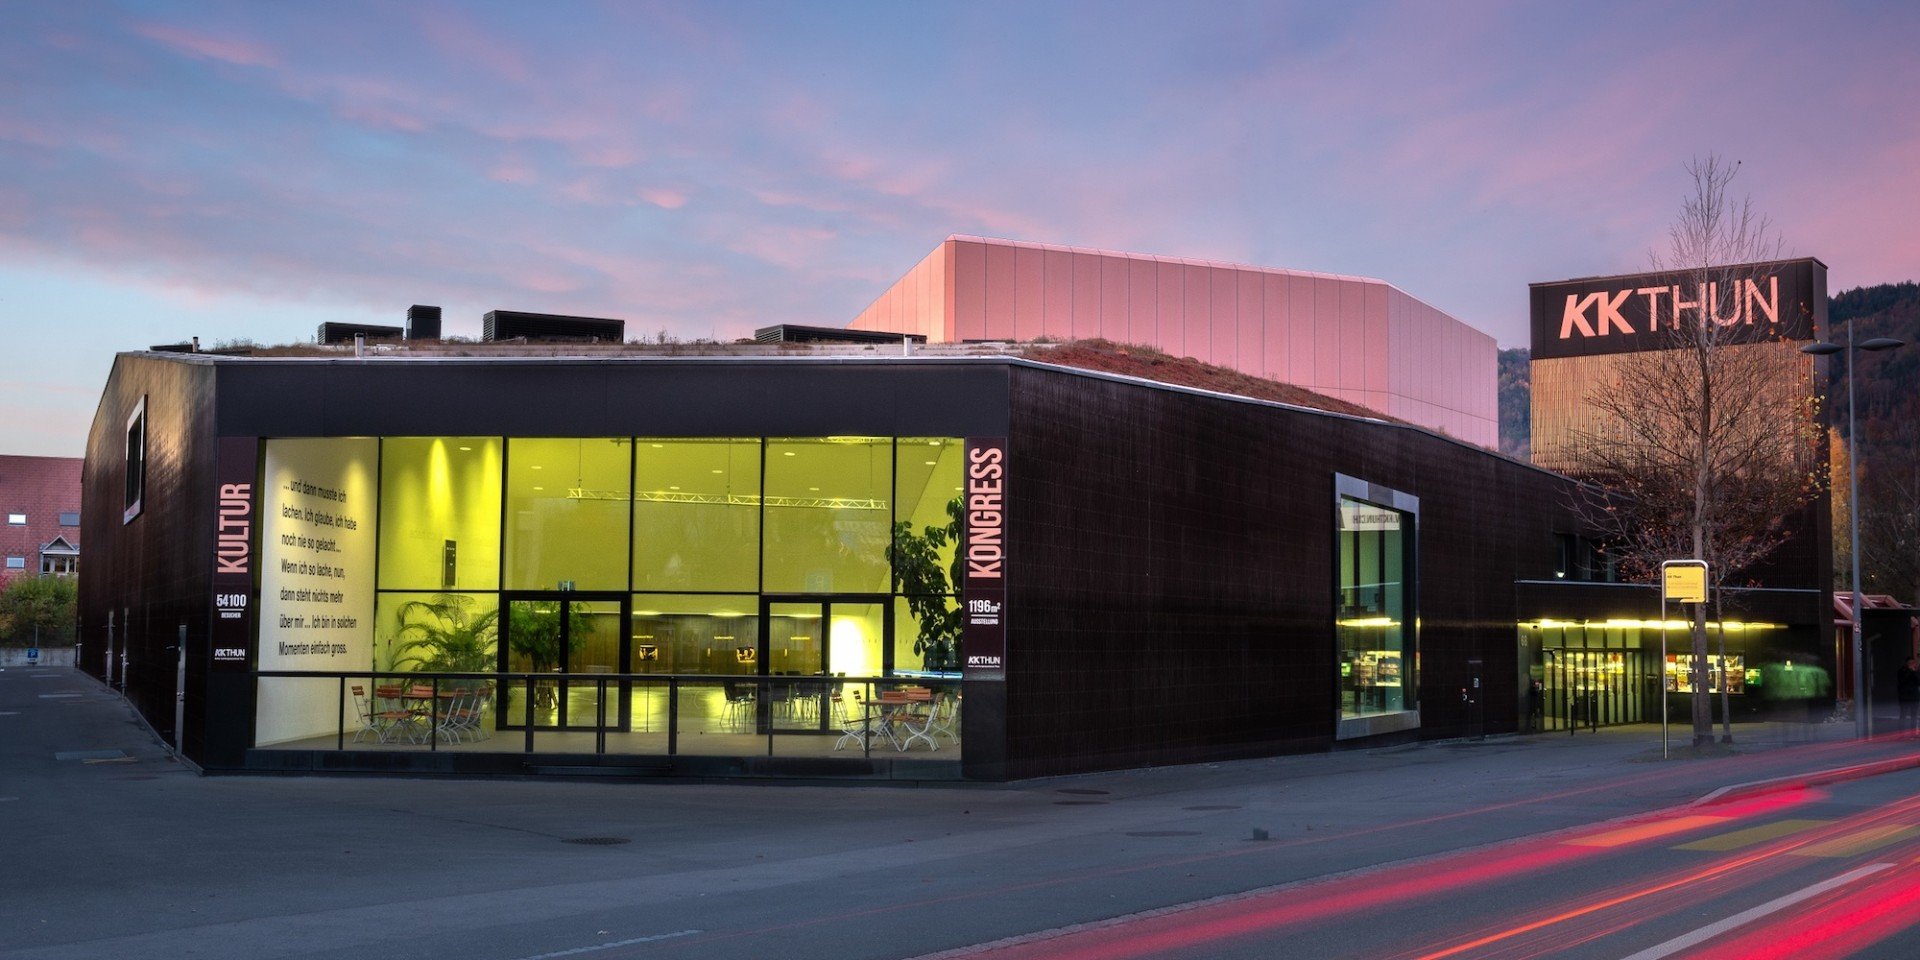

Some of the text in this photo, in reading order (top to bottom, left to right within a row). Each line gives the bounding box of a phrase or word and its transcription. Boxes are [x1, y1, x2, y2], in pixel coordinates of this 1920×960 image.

[291, 479, 301, 493] und
[303, 481, 316, 497] dann
[318, 487, 337, 501] musste
[338, 488, 346, 503] ich
[283, 502, 356, 530] lachen. Ich glaube, ich habe
[969, 447, 1003, 578] KONGRESS
[217, 483, 251, 574] KULTUR
[282, 532, 296, 546] noch
[298, 534, 306, 548] nie
[308, 538, 314, 549] so
[281, 558, 345, 580] Wenn ich so lache, nun,
[280, 586, 343, 603] dann steht nichts mehr
[280, 613, 293, 628] über
[294, 614, 304, 628] mir
[312, 614, 320, 628] Ich
[321, 615, 330, 628] bin
[331, 615, 336, 628] in
[337, 615, 357, 628] solchen
[279, 640, 347, 657] Momenten einfach gross.
